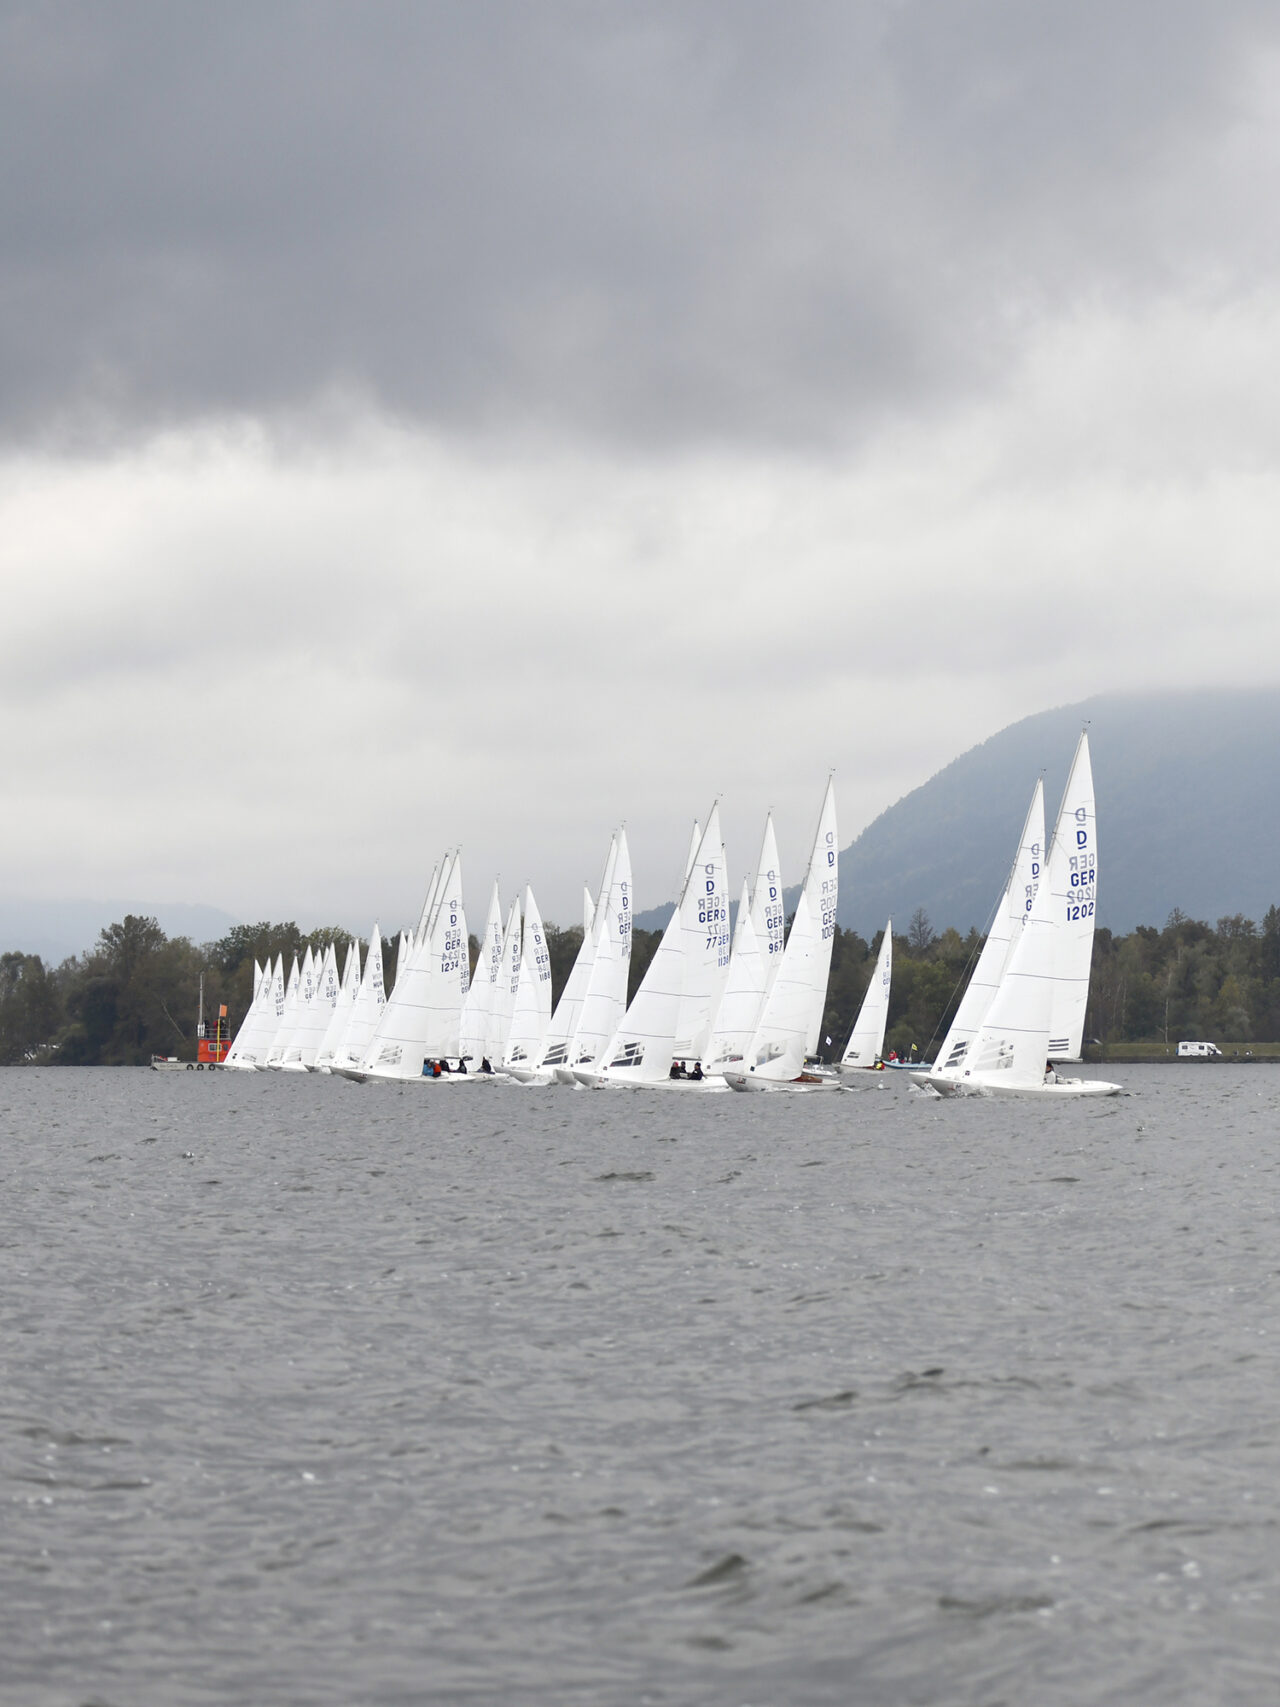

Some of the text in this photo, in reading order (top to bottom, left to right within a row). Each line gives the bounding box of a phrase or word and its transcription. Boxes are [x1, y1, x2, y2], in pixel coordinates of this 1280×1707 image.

[1076, 831, 1087, 849] D
[828, 851, 835, 867] D
[1032, 863, 1039, 879] D
[1071, 869, 1095, 887] GER
[706, 881, 715, 895] D
[769, 887, 777, 901] D
[622, 897, 628, 910] D
[699, 909, 719, 923] GER
[1067, 902, 1094, 921] 1202
[450, 914, 457, 927] D
[767, 915, 782, 929] GER
[445, 939, 461, 951] GER
[535, 934, 541, 945] D
[706, 937, 717, 950] 77
[769, 940, 783, 954] 967
[441, 960, 459, 972] 1234
[536, 954, 548, 964] GER
